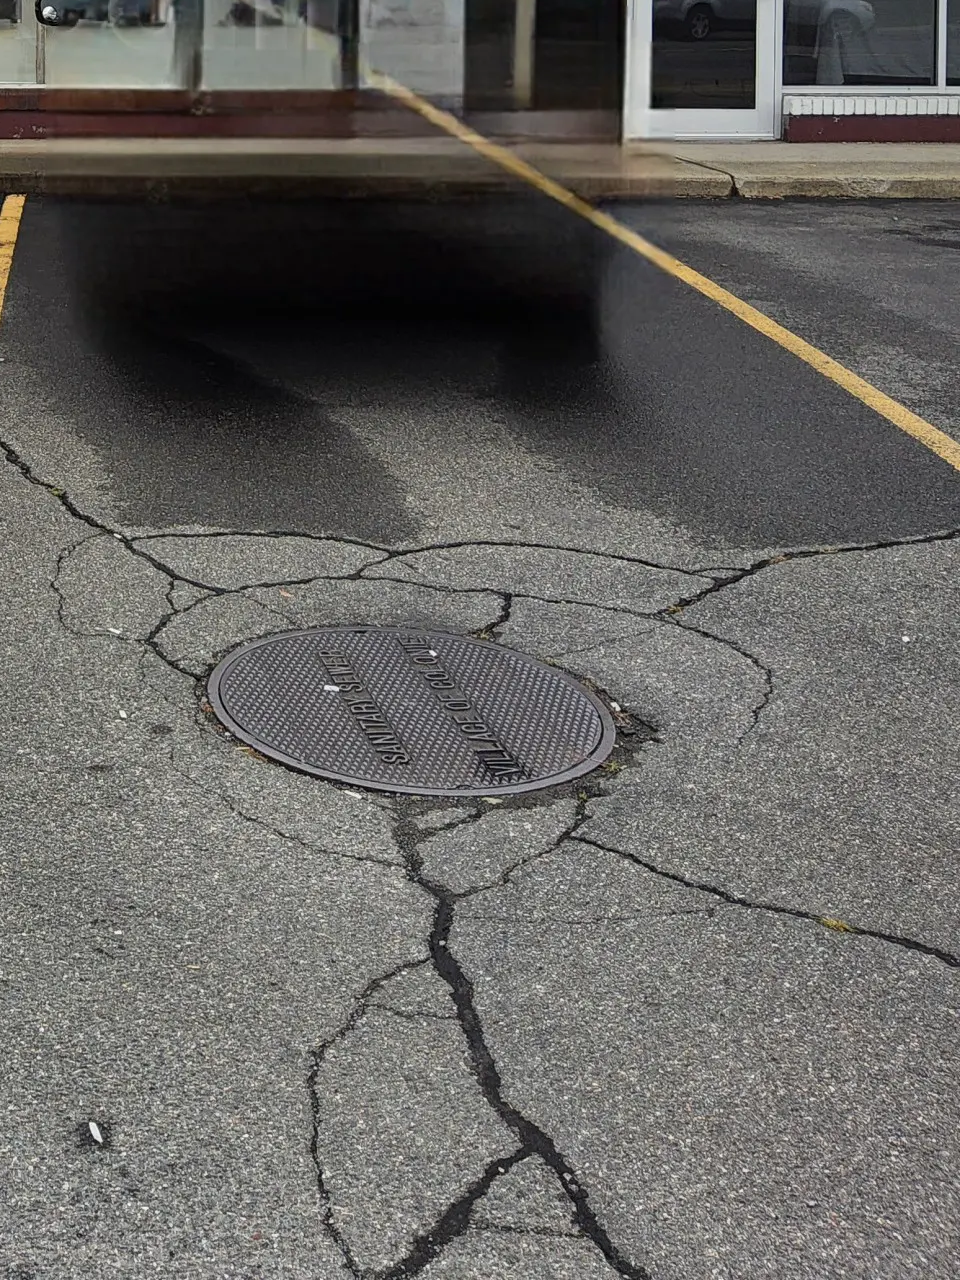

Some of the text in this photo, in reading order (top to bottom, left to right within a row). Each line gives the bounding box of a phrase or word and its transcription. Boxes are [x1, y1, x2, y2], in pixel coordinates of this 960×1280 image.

[319, 649, 411, 764] SANITARY SEWER
[437, 693, 470, 710] OF
[452, 715, 523, 777] VILLAGE
